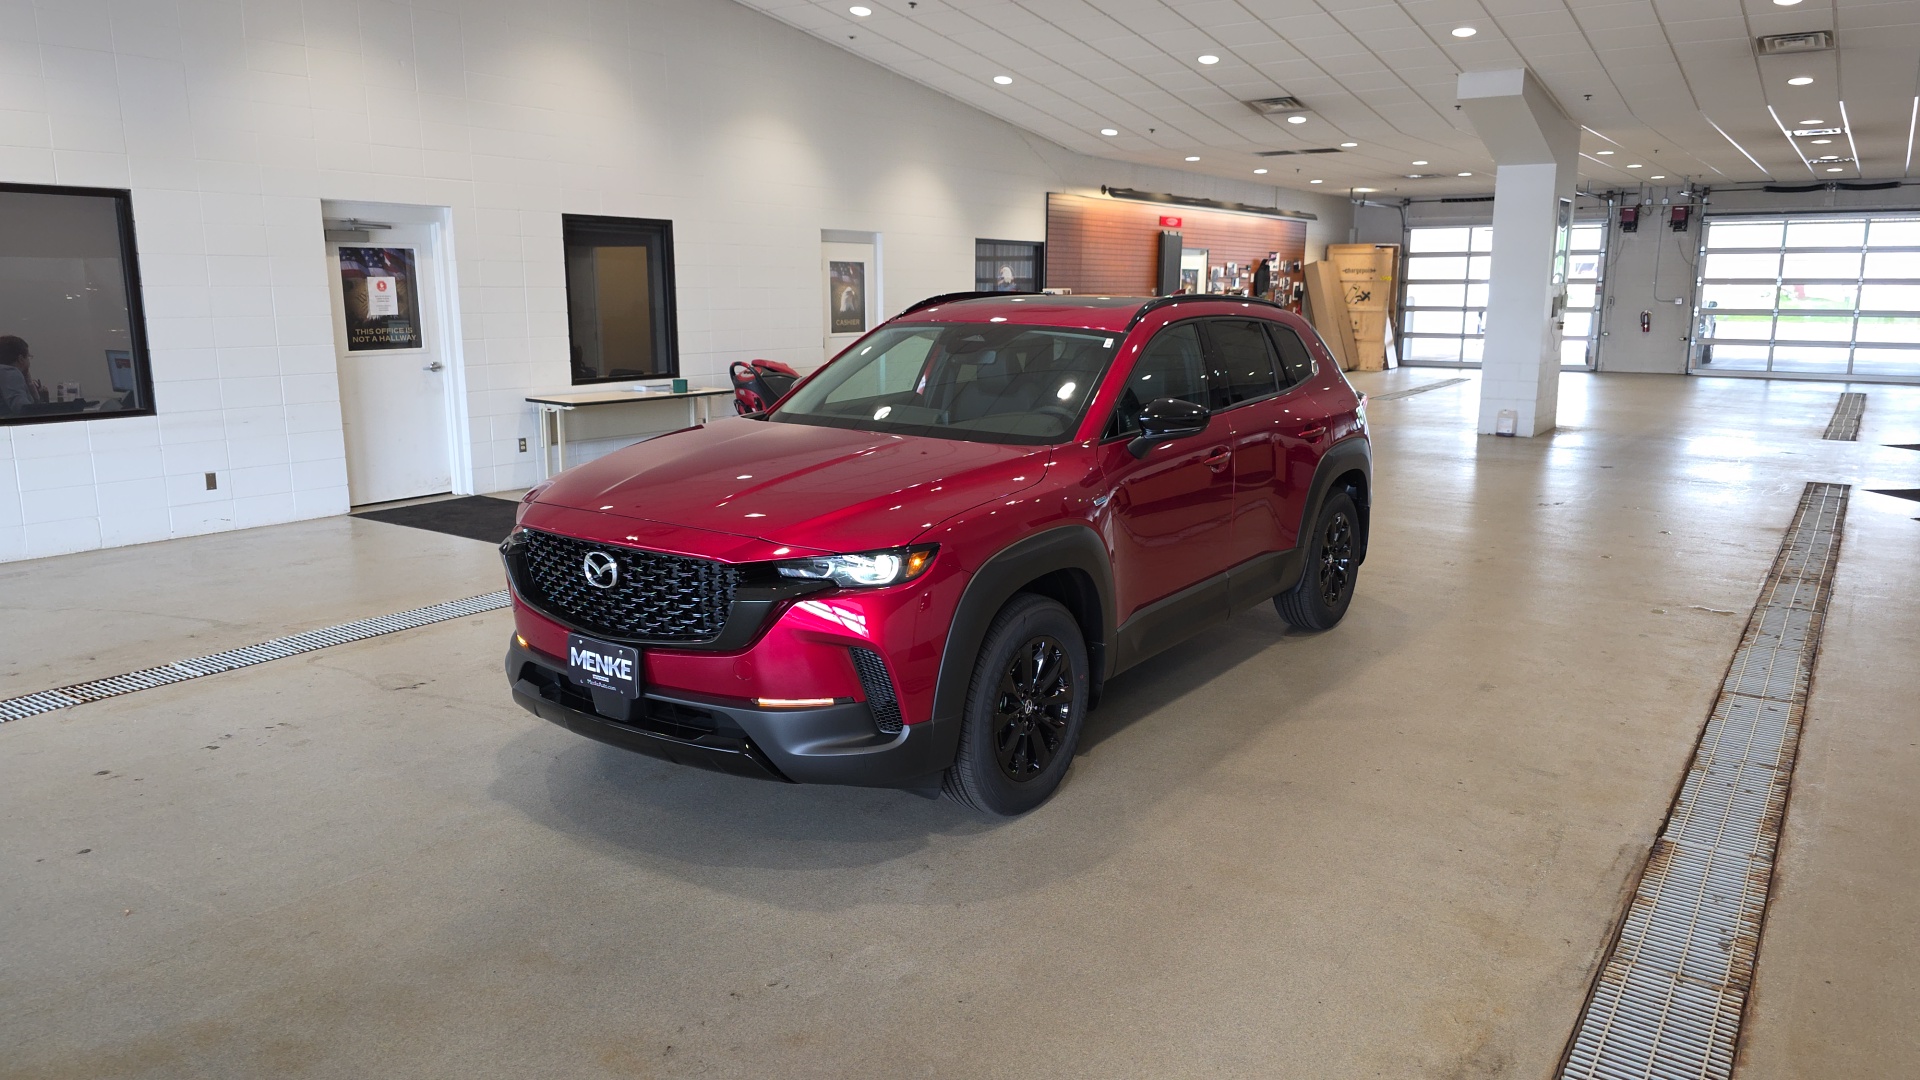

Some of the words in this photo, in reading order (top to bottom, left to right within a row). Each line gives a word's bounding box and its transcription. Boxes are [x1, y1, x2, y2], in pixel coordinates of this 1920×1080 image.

[375, 327, 405, 335] OFFICE
[379, 334, 417, 342] HALLWAY
[570, 646, 632, 681] MENKE
